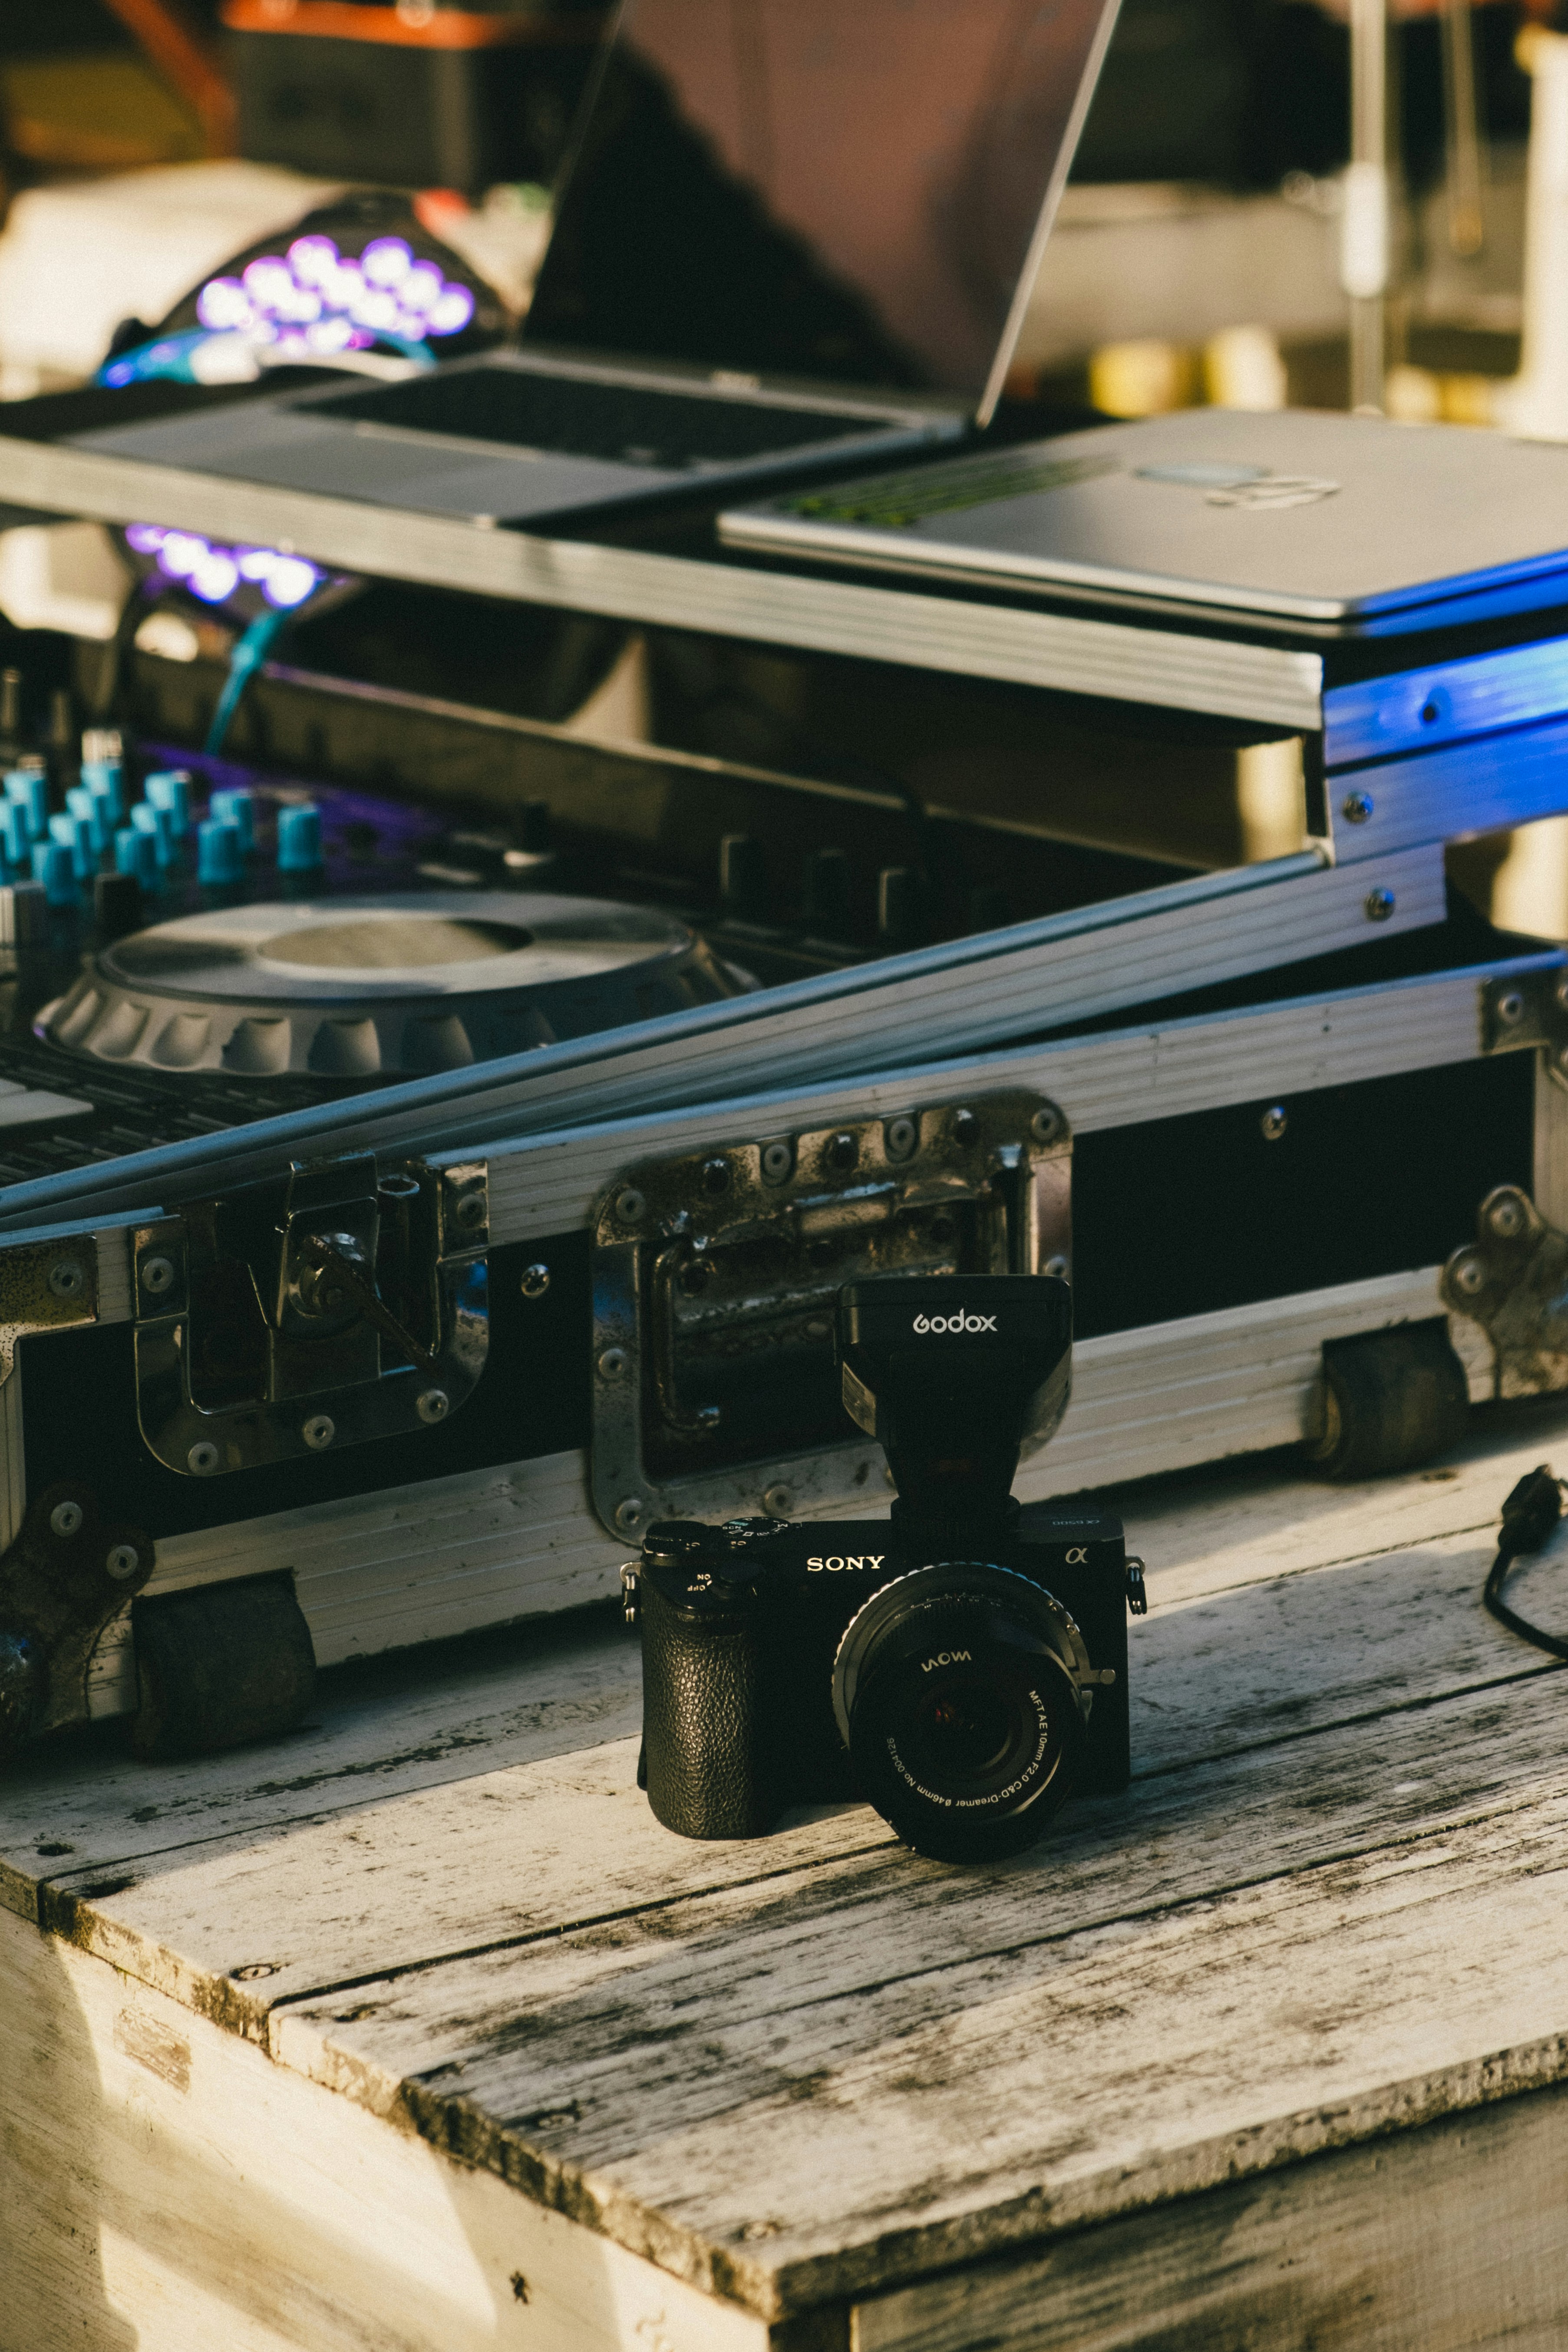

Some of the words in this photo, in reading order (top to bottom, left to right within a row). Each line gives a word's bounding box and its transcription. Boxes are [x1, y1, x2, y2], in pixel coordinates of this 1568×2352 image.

[913, 1308, 998, 1334] Godox
[806, 1553, 885, 1572] SONY
[1029, 1691, 1045, 1711] MFT
[1038, 1714, 1048, 1729] AE
[1035, 1732, 1048, 1761] 10mm
[1022, 1762, 1039, 1782] F2.0
[956, 1781, 1022, 1807] C&D-Dreamer
